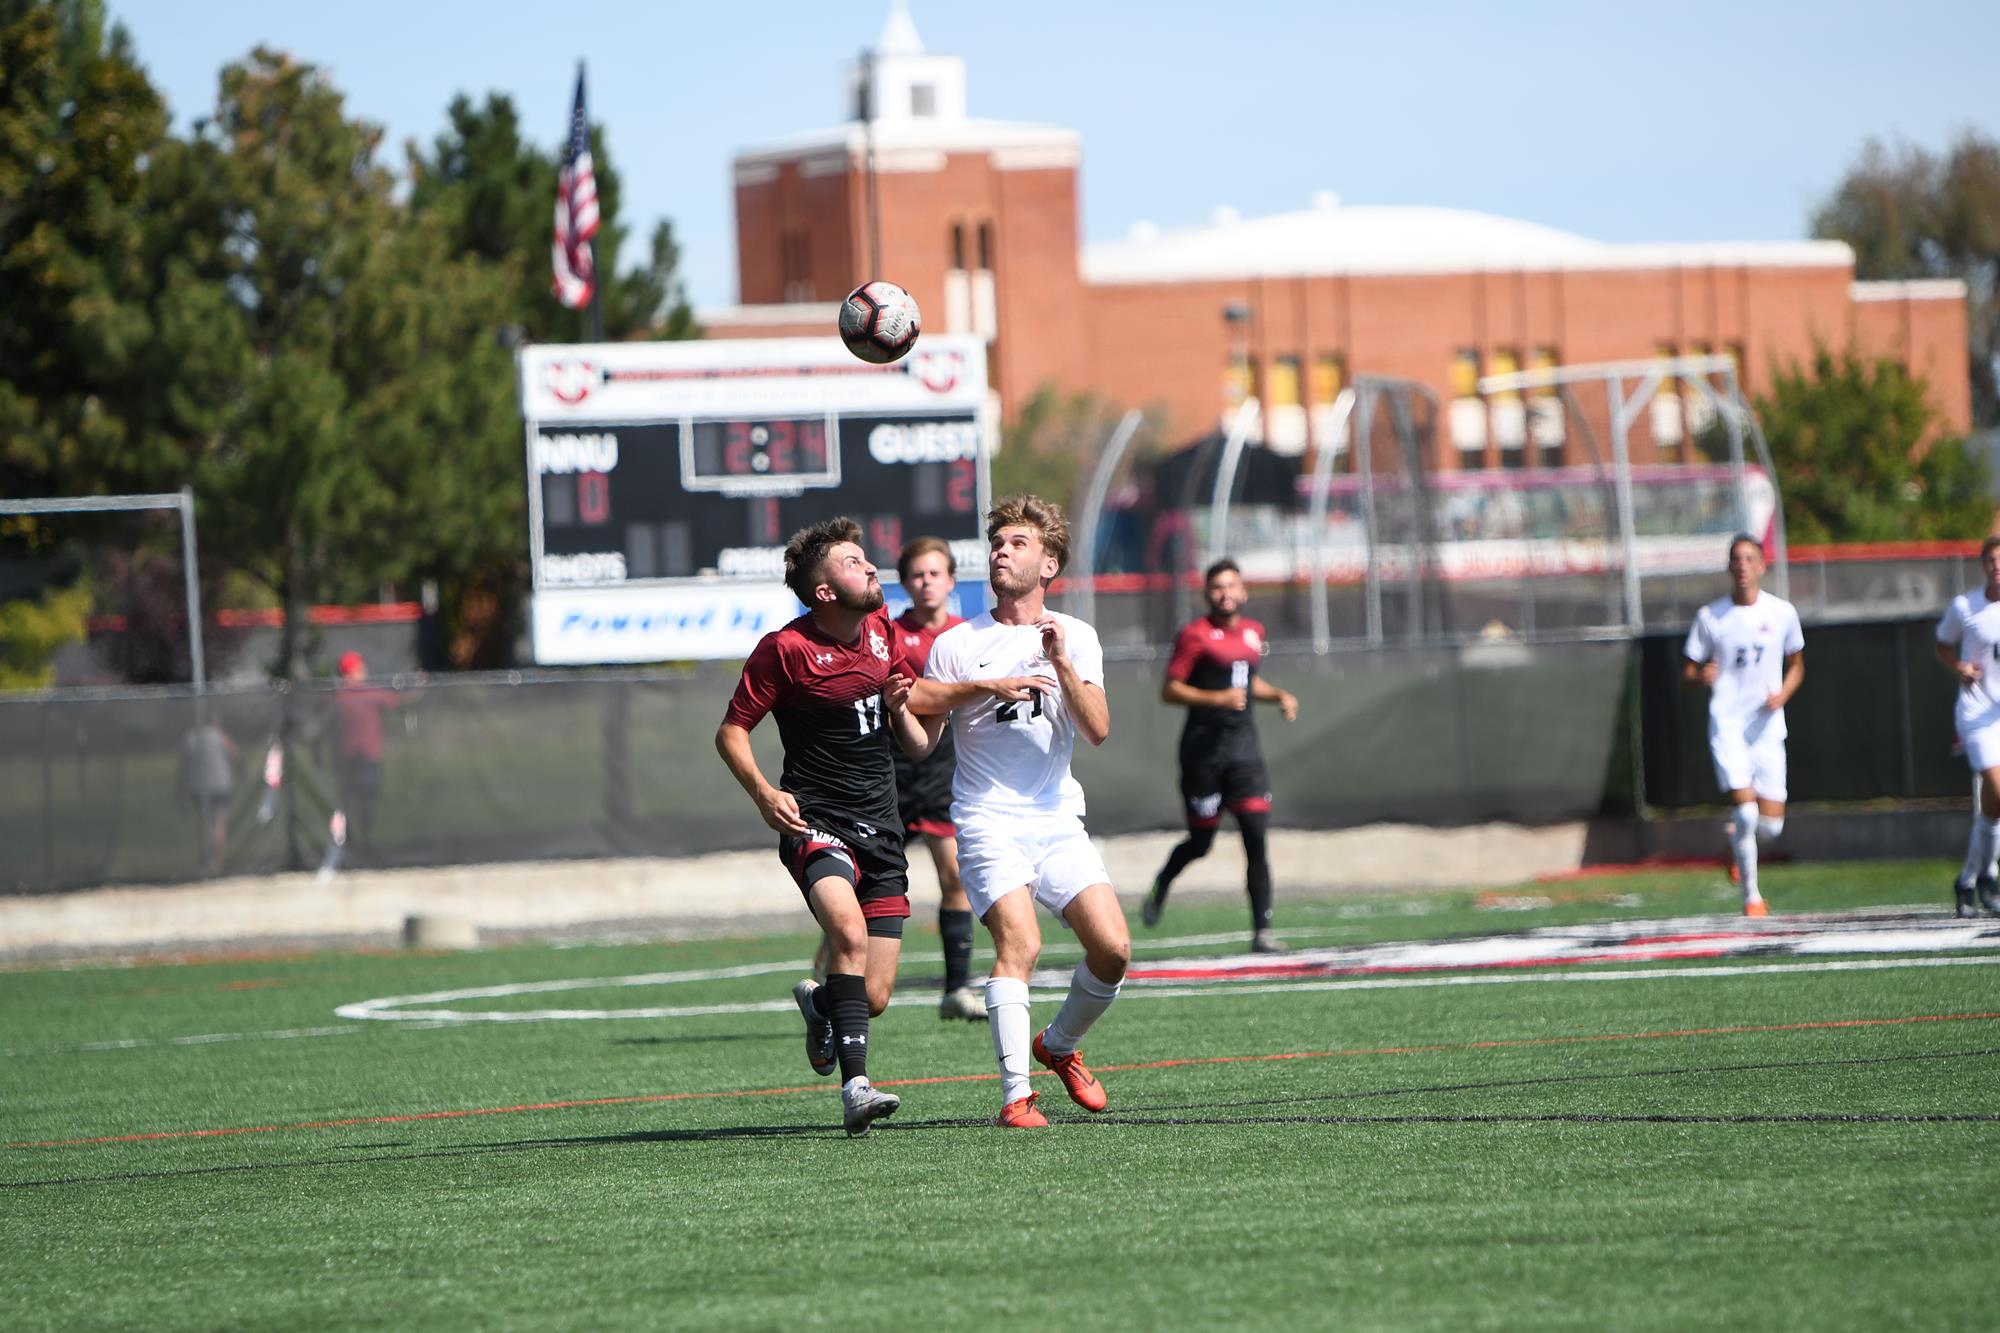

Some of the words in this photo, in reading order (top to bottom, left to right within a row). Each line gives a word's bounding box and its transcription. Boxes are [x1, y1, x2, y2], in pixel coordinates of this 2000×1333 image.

[536, 432, 619, 474] NNU
[868, 422, 980, 465] GUEST
[577, 469, 611, 525] 0
[946, 457, 978, 513] 2
[560, 604, 717, 634] Powered
[730, 605, 768, 633] by
[854, 693, 882, 736] 17
